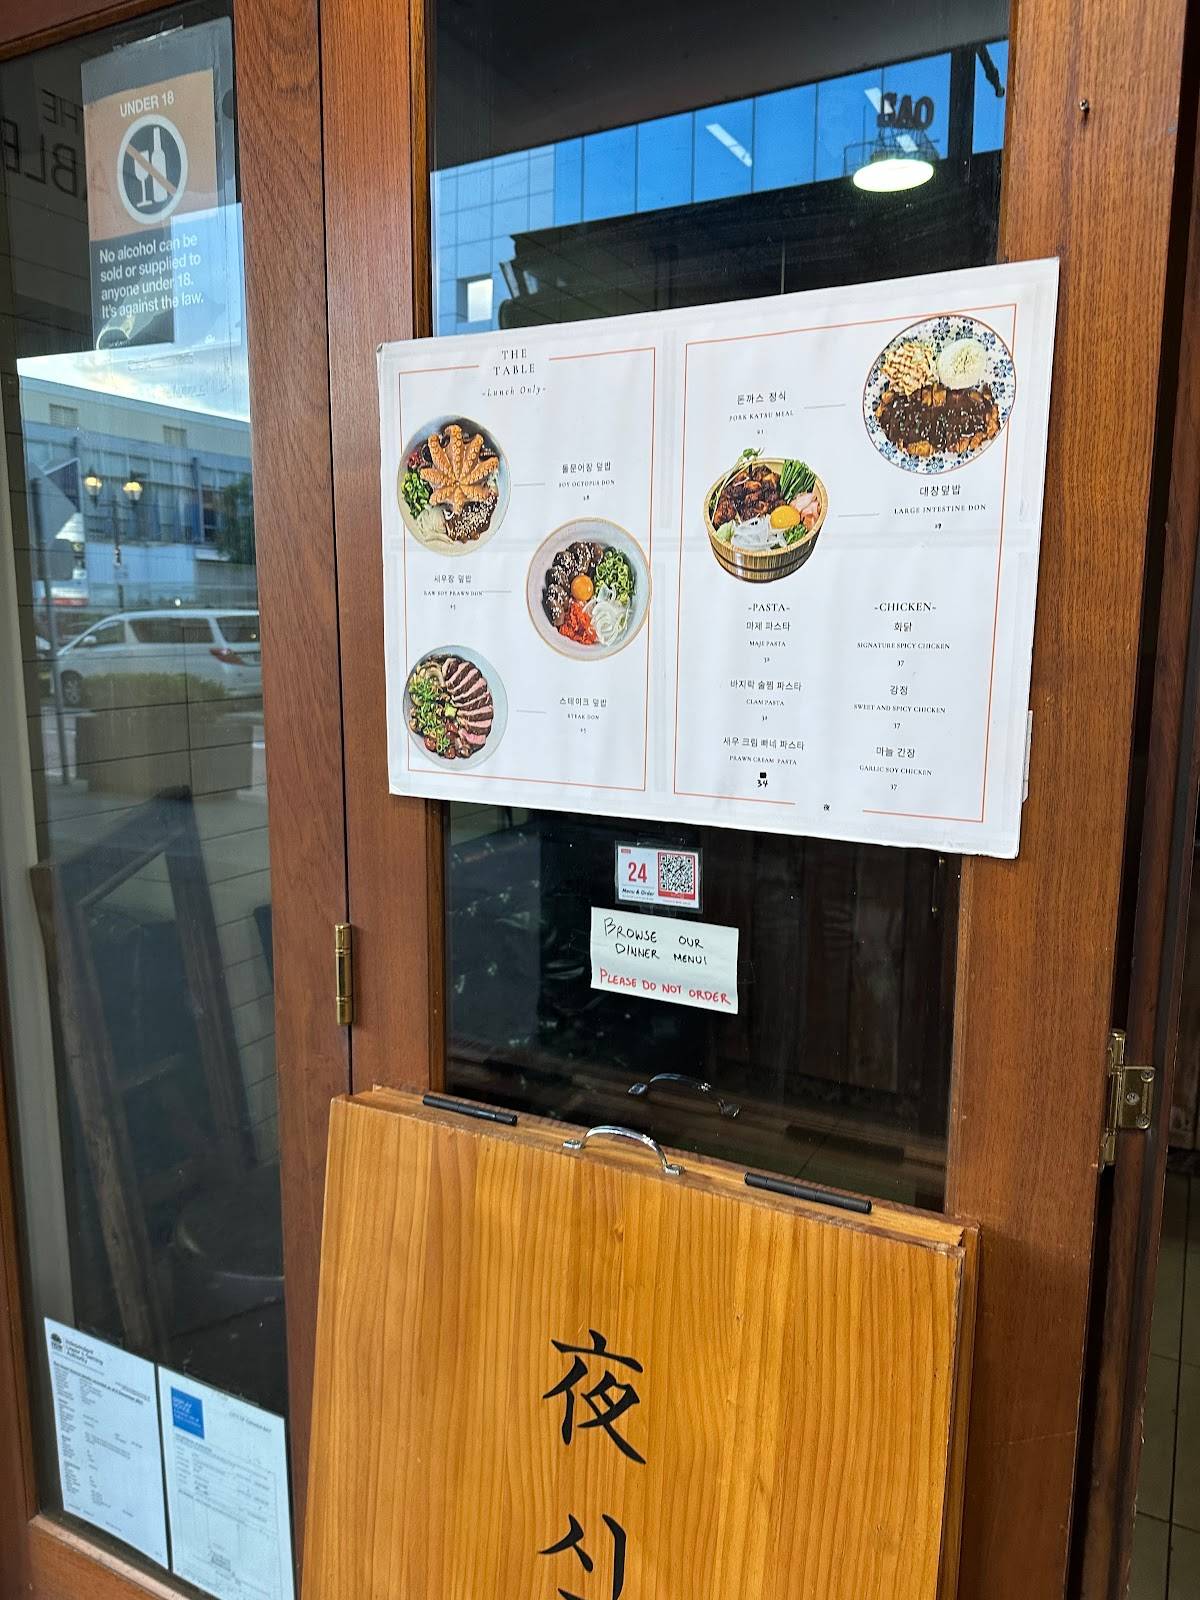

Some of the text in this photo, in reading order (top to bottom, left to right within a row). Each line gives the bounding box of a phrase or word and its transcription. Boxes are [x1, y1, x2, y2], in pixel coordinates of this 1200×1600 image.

[120, 89, 175, 117] UNDER 18
[100, 233, 198, 264] No alcohol can be
[100, 254, 201, 282] sold or supplied to
[101, 272, 194, 302] anyone under 18.
[102, 292, 204, 319] It's against the law.
[501, 348, 527, 360] THE
[493, 363, 535, 376] TABLE
[737, 390, 786, 405] 돈까스 정식
[750, 412, 773, 420] KATSU
[919, 484, 961, 497] 대창덮밥
[923, 505, 966, 513] INTESTINE
[748, 603, 790, 612] -PASTA-
[874, 602, 936, 612] -CHICKEN-
[765, 621, 790, 631] 파스타
[730, 679, 755, 690] 바지락
[777, 681, 802, 692] 파스타
[890, 684, 908, 695] 강정
[742, 737, 758, 748] 크림
[780, 740, 804, 750] 파스타
[898, 747, 915, 758] 간장
[900, 768, 932, 776] CHICKEN
[757, 779, 768, 787] 34
[628, 862, 647, 883] 24
[603, 917, 704, 949] BROWSE OUR
[615, 942, 660, 960] DINNER
[600, 968, 731, 1005] PLEASE DO NOT ORDER
